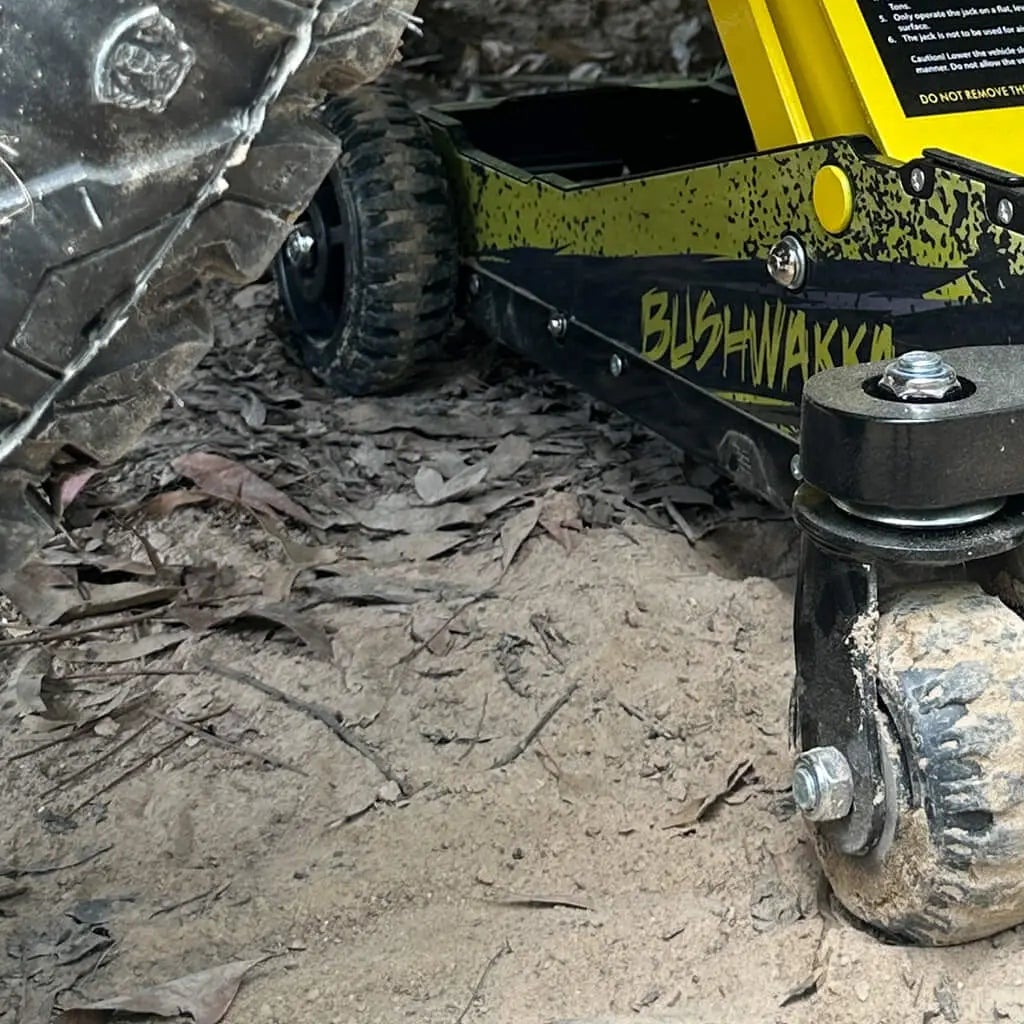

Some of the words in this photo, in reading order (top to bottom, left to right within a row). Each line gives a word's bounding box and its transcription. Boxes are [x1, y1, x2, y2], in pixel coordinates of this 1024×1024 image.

[878, 14, 888, 23] 5.
[893, 12, 913, 22] Only
[914, 11, 946, 21] operate
[946, 9, 961, 17] the
[961, 7, 979, 18] jack
[888, 3, 911, 11] Tons.
[887, 35, 897, 44] 6.
[901, 34, 919, 42] The
[918, 32, 937, 43] jack
[936, 31, 945, 40] is
[945, 30, 961, 39] not
[969, 28, 982, 37] be
[982, 26, 1003, 36] used
[1002, 26, 1015, 34] for
[897, 22, 931, 32] surface.
[946, 51, 972, 60] Lower
[971, 49, 987, 58] the
[987, 46, 1016, 56] vehicle
[915, 65, 950, 74] manner.
[949, 62, 963, 71] Do
[963, 61, 979, 70] not
[979, 59, 1001, 68] allow
[1001, 58, 1016, 66] the
[919, 93, 938, 104] DO
[938, 90, 963, 103] NOT
[964, 86, 1009, 100] REMOVE
